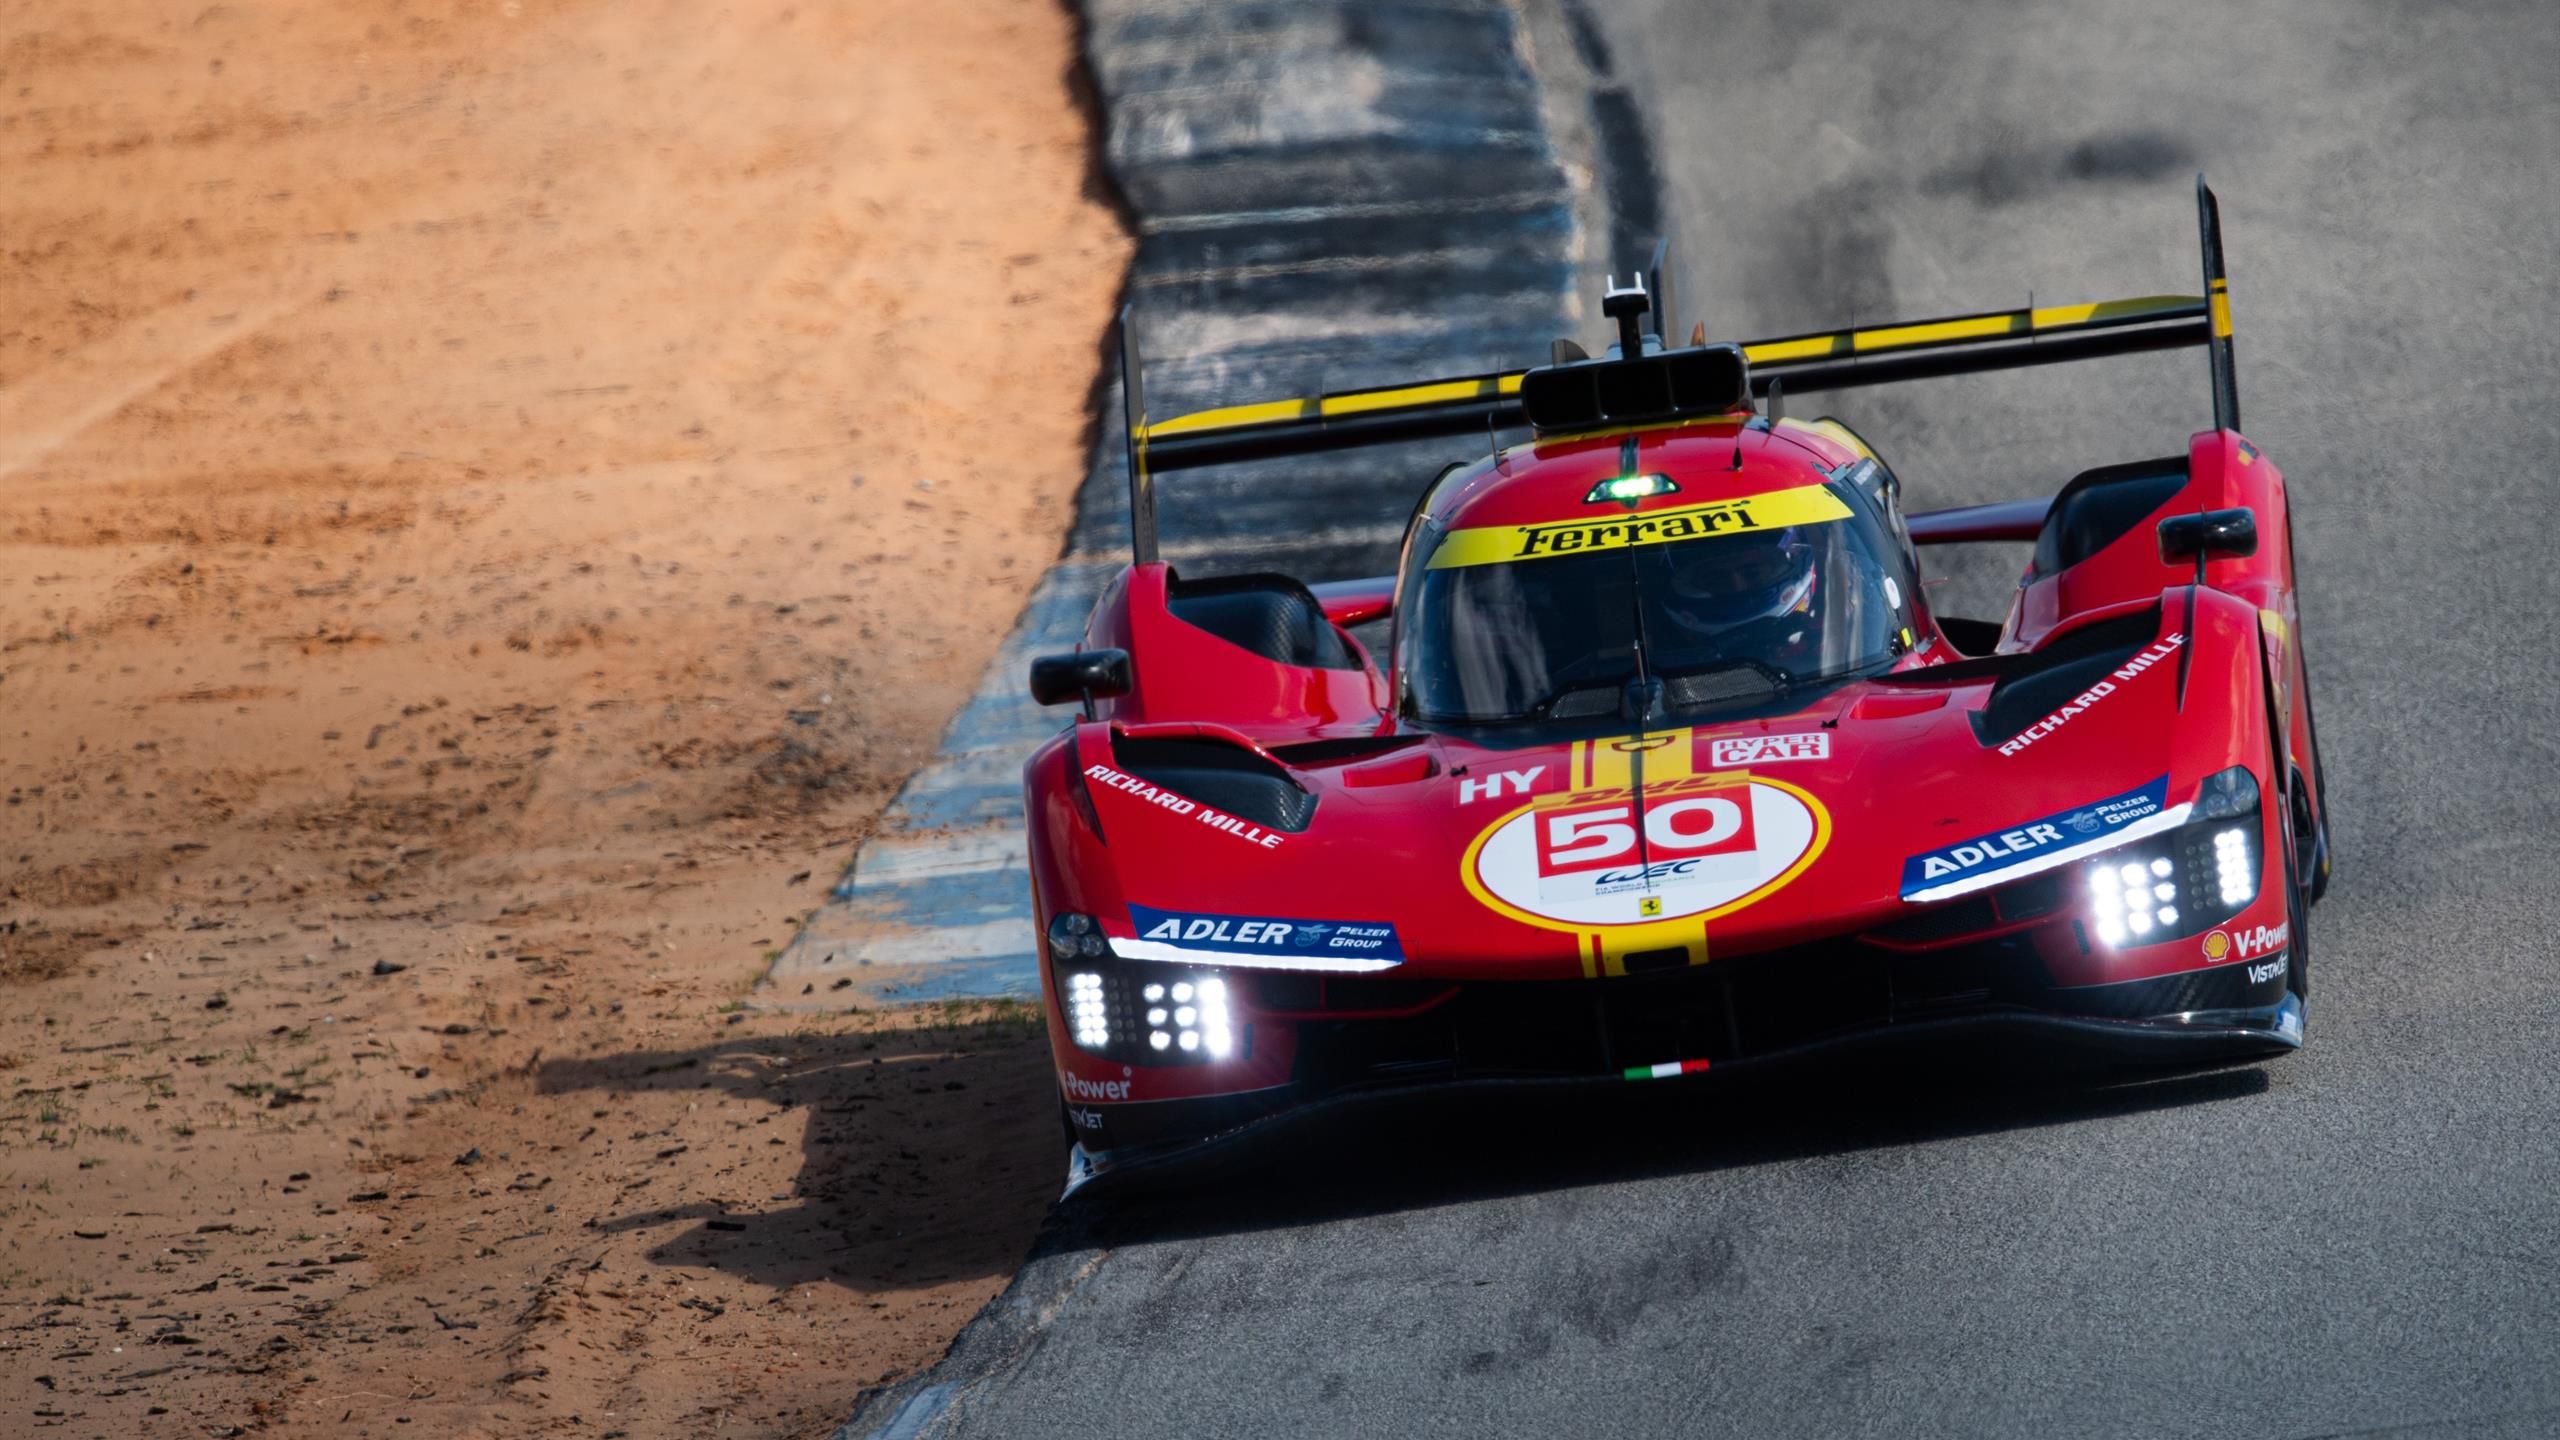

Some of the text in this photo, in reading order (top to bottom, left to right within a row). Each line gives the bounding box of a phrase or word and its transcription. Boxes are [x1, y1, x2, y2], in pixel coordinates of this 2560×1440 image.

[1514, 503, 1760, 557] Ferrari
[1999, 632, 2190, 757] RICHARD MILLE
[1719, 735, 1821, 749] HYPER
[1720, 743, 1820, 762] CAR
[1460, 766, 1546, 804] HY
[1567, 776, 1711, 806] DHL
[1084, 764, 1284, 848] RICHARD MILLE
[1548, 797, 1742, 865] 50
[1922, 823, 2064, 880] ADLER
[1595, 858, 1702, 885] WEC
[1144, 918, 1293, 945] ADLER
